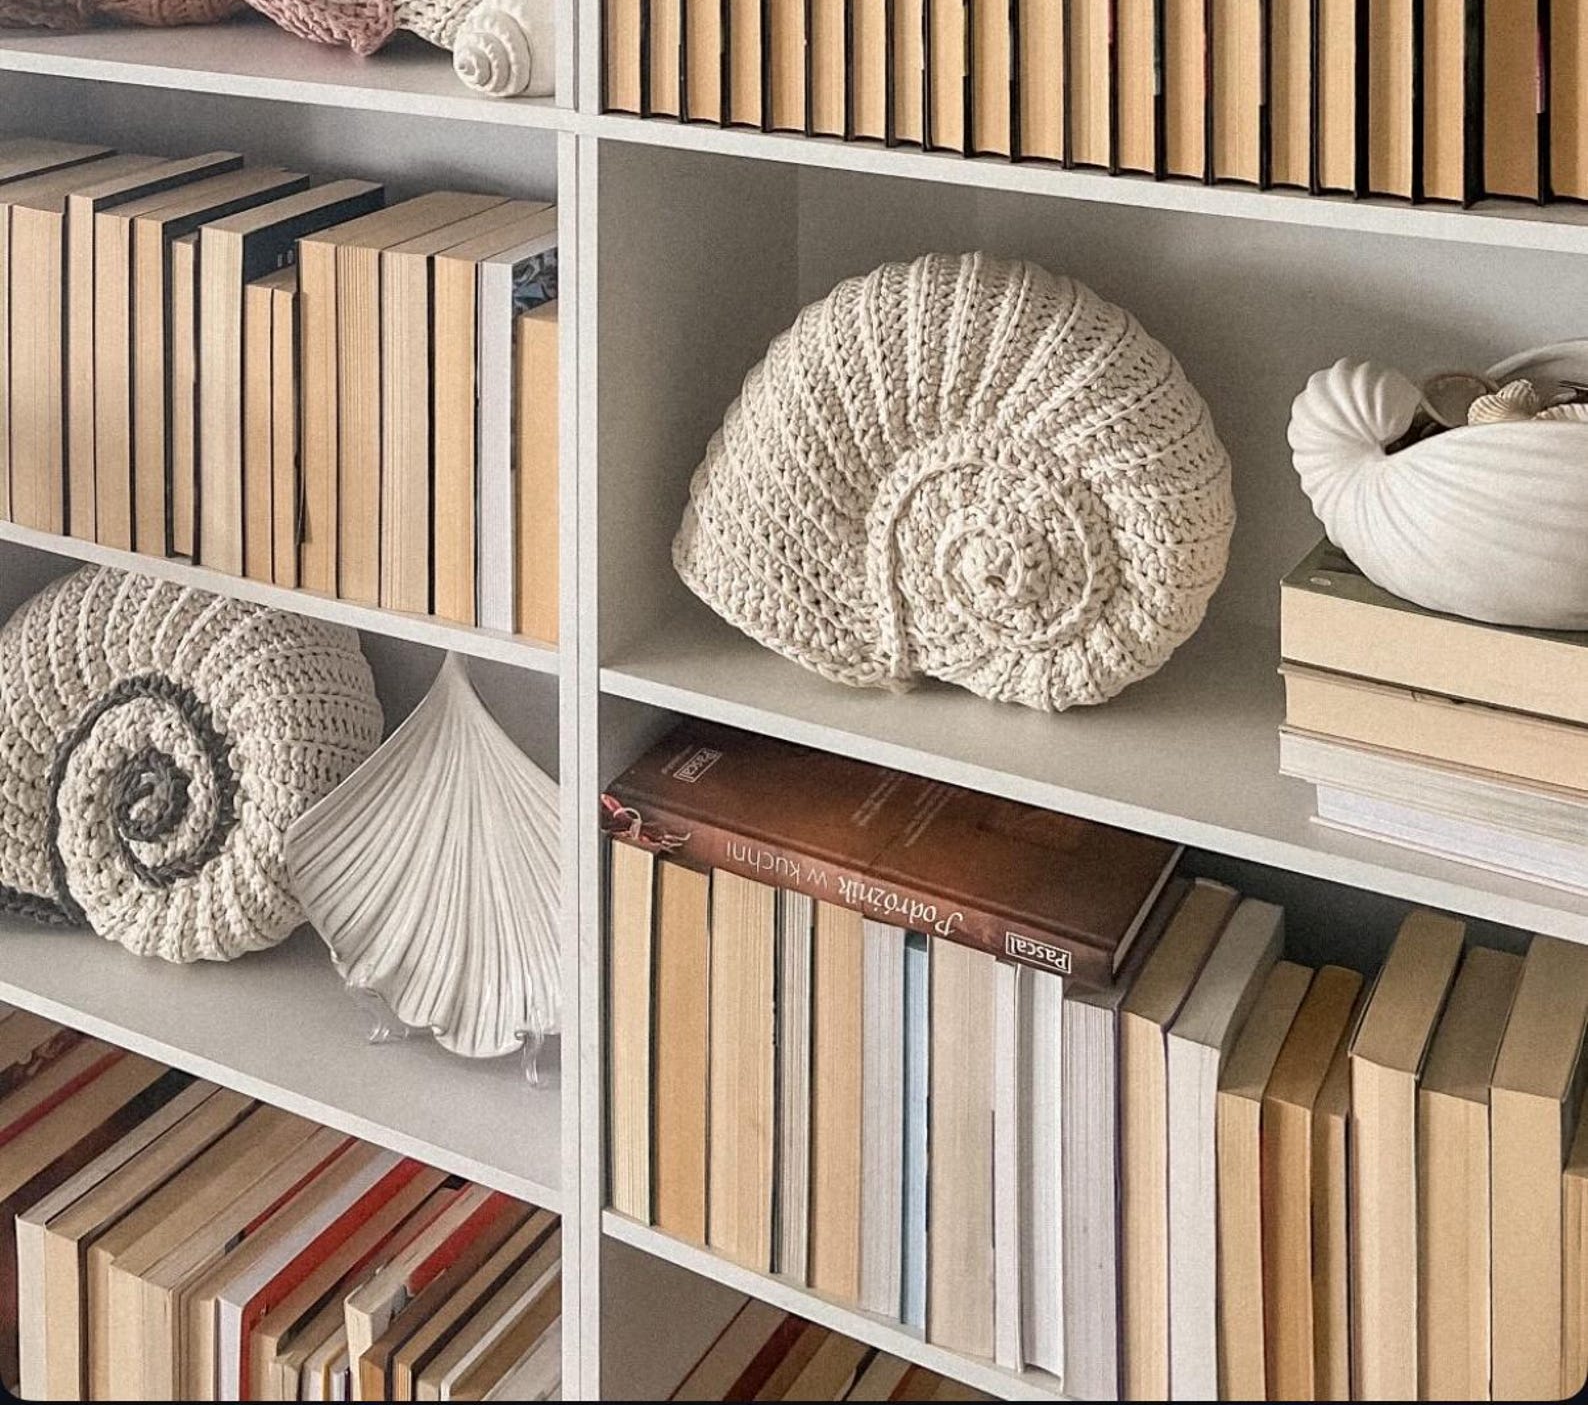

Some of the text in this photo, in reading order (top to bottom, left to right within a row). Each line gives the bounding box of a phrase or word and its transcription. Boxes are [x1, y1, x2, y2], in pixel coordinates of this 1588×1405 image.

[678, 749, 718, 780] Pascal
[726, 841, 964, 936] Podróżnik w kuchni
[1010, 936, 1068, 969] Pascal
